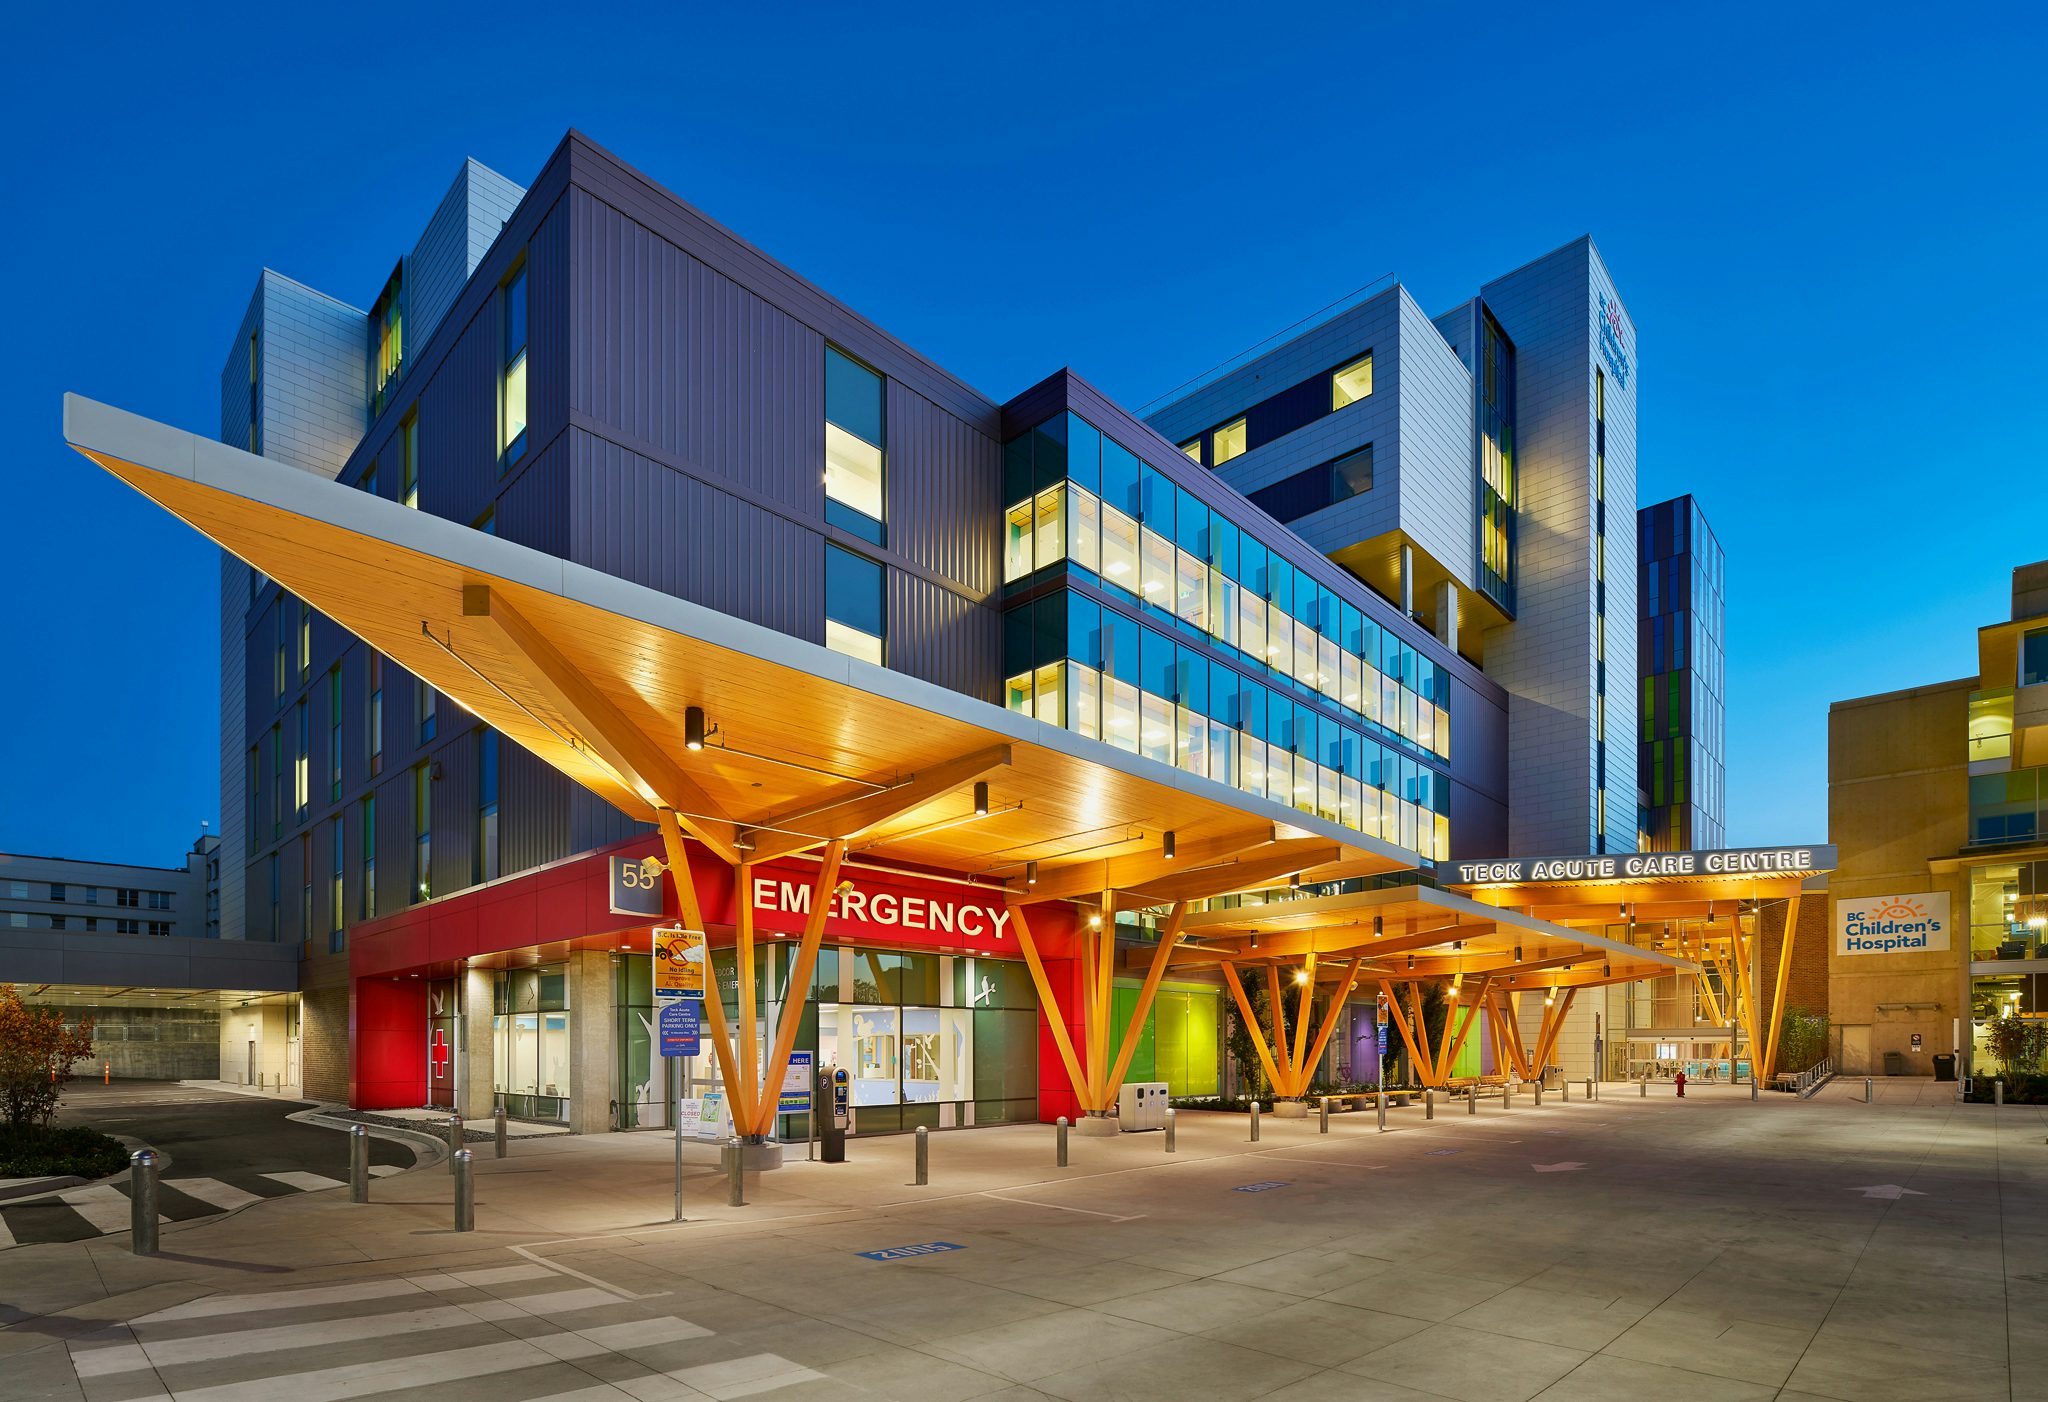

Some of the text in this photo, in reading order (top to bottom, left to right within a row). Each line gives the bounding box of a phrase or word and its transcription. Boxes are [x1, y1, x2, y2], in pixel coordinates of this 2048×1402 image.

[1461, 850, 1811, 881] TECK ACUTE CARE CENTRE
[622, 863, 655, 890] 55
[1847, 912, 1866, 922] BC
[1845, 918, 1942, 937] Children's
[1846, 933, 1928, 952] Hospital
[678, 966, 695, 976] Idling
